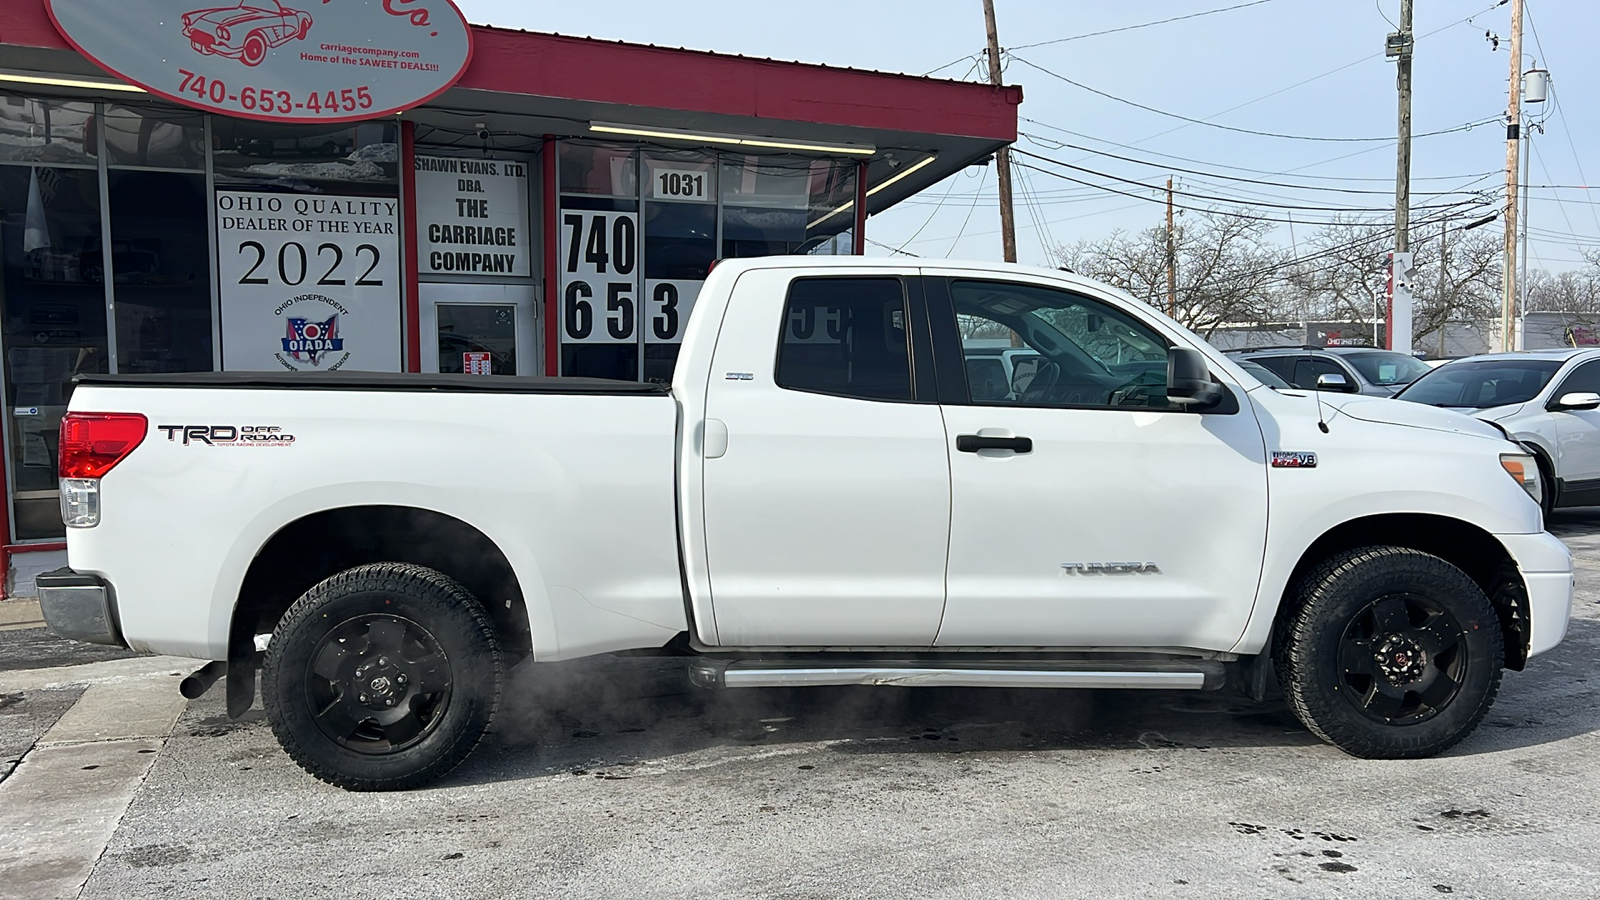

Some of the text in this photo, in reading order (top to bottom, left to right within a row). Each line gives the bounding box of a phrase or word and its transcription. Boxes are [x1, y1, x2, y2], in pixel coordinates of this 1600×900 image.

[320, 43, 420, 59] carriagecompany.com
[300, 52, 440, 72] Home of the SAWEET DEALS!!!
[178, 68, 373, 114] 740-653-4455
[415, 158, 526, 178] SHAWN EVANS. LTD.
[457, 179, 485, 193] DBA.
[659, 172, 703, 197] 1031
[219, 196, 396, 216] OHIO QUALITY
[455, 198, 489, 218] THE
[222, 217, 394, 235] DEALER OF THE YEAR
[428, 223, 516, 246] CARRIAGE
[564, 214, 635, 275] 740
[238, 240, 384, 287] 2022
[430, 251, 516, 273] COMPANY
[274, 293, 349, 316] OHIO INDEPENDENT
[289, 340, 334, 351] OIADA
[158, 425, 282, 446] TRD OFF
[240, 434, 295, 443] ROAD
[1298, 454, 1315, 465] V8
[1061, 562, 1163, 577] TUNDRA
